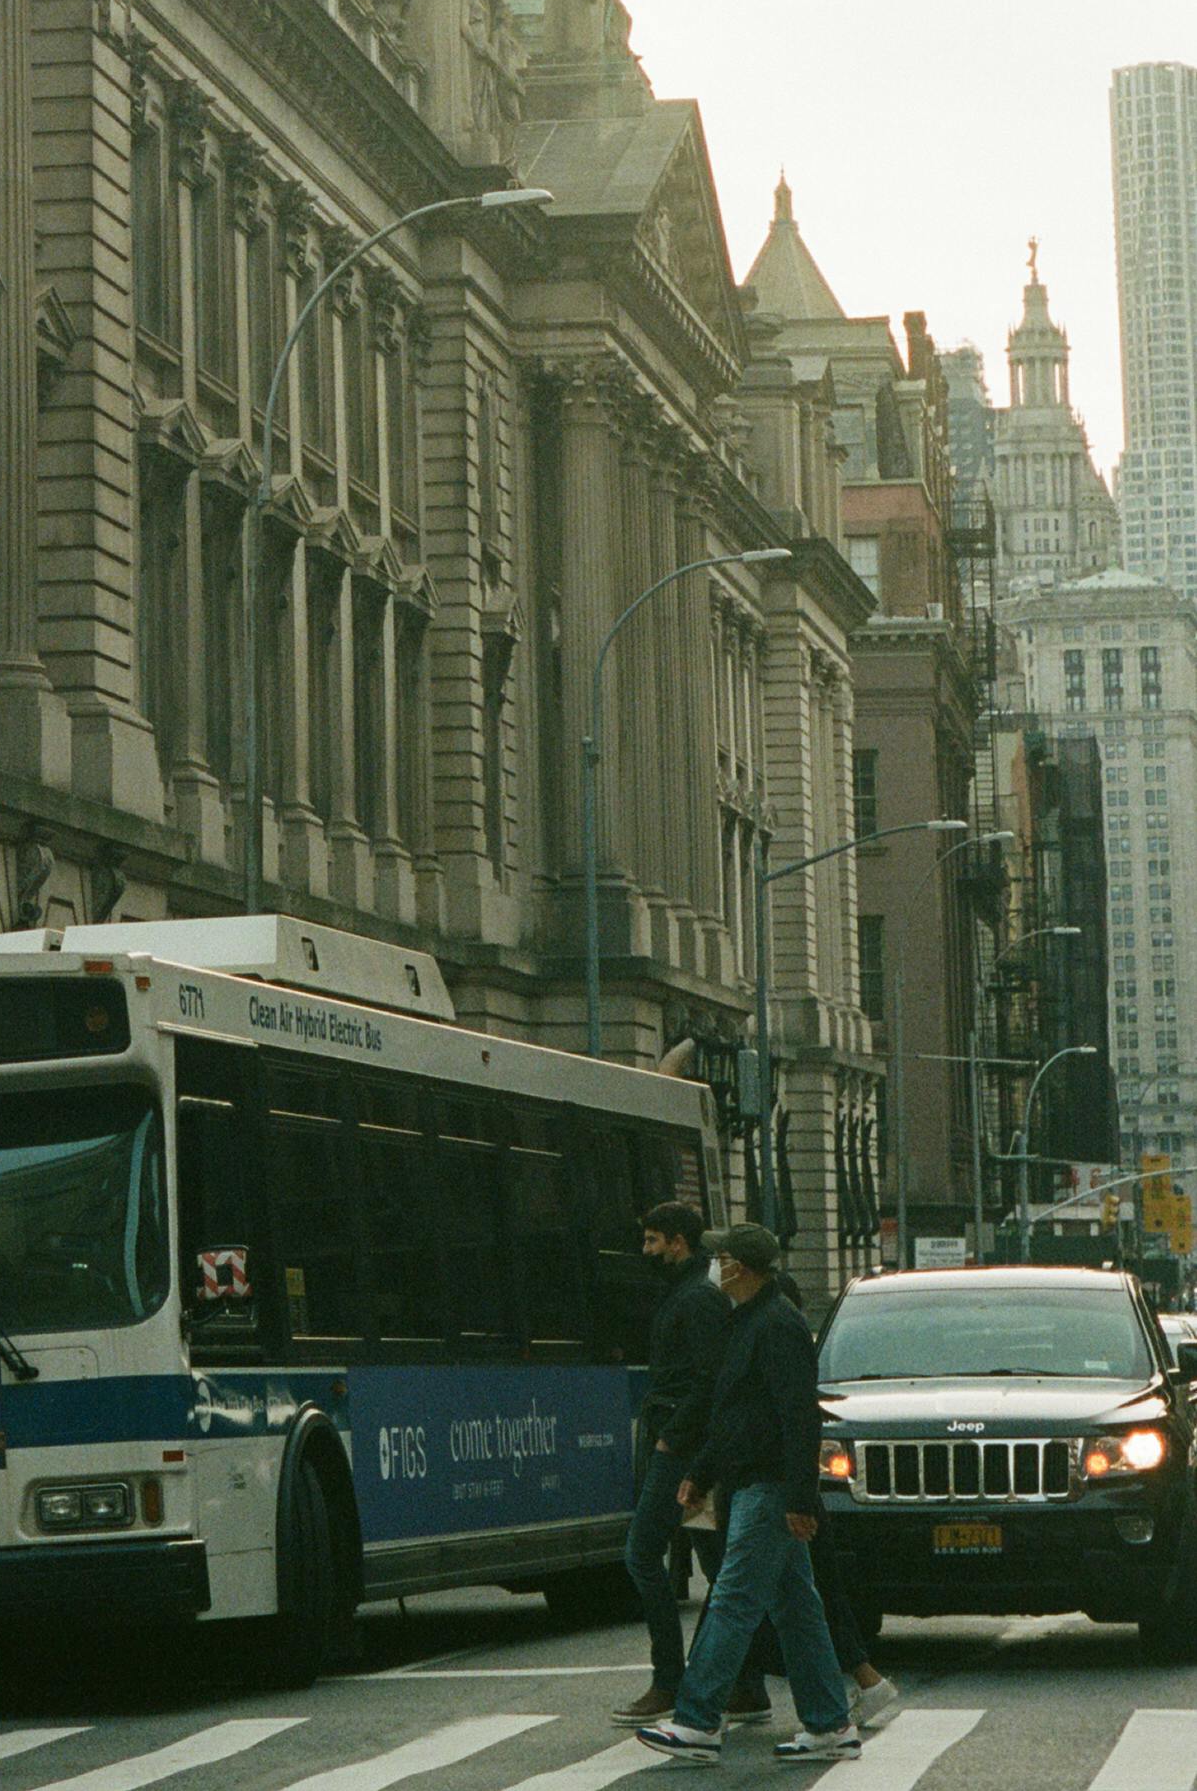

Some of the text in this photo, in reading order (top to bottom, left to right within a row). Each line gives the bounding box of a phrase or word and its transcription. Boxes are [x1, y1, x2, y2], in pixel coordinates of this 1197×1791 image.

[178, 984, 205, 1019] 6771
[249, 996, 382, 1051] Clean Air Hybrid Electric Bus
[390, 1426, 427, 1479] FIGS
[450, 1397, 556, 1478] come together
[946, 1420, 985, 1433] Jeep
